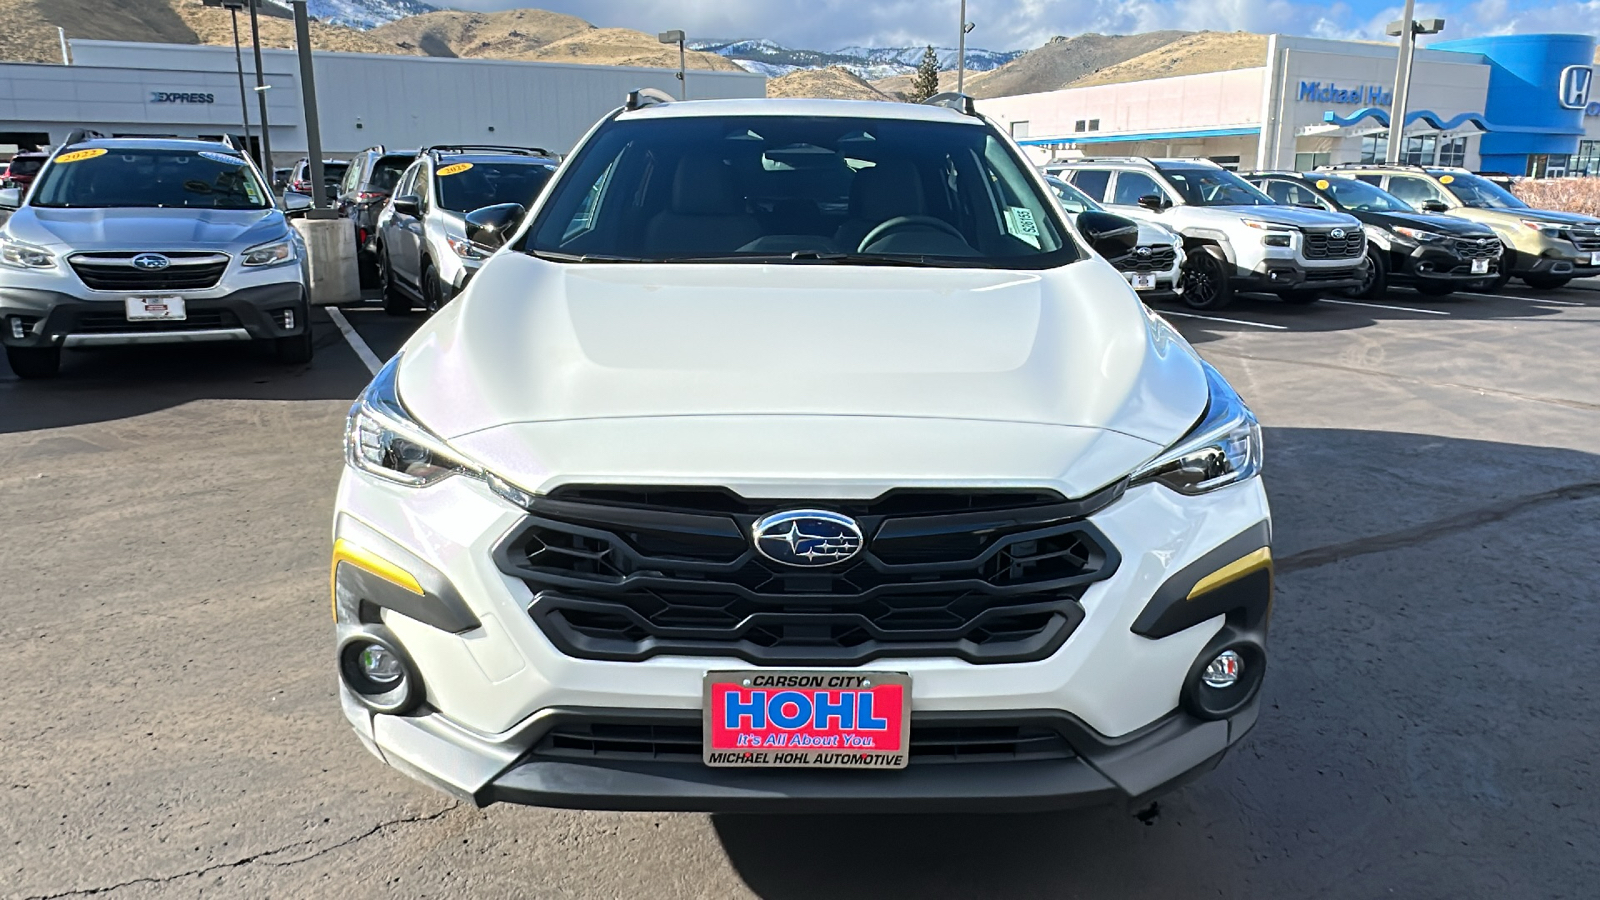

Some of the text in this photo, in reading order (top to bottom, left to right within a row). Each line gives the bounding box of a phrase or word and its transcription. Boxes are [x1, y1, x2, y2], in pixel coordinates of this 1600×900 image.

[156, 91, 214, 103] EXPRESS
[1299, 81, 1392, 106] Michael Ho
[64, 150, 97, 161] 2022
[753, 675, 867, 688] CARSON CITY
[725, 691, 887, 730] HOHL
[737, 733, 875, 747] It's All About You.
[708, 752, 904, 766] MICHAEL HOHL AUTOMOTIVE
